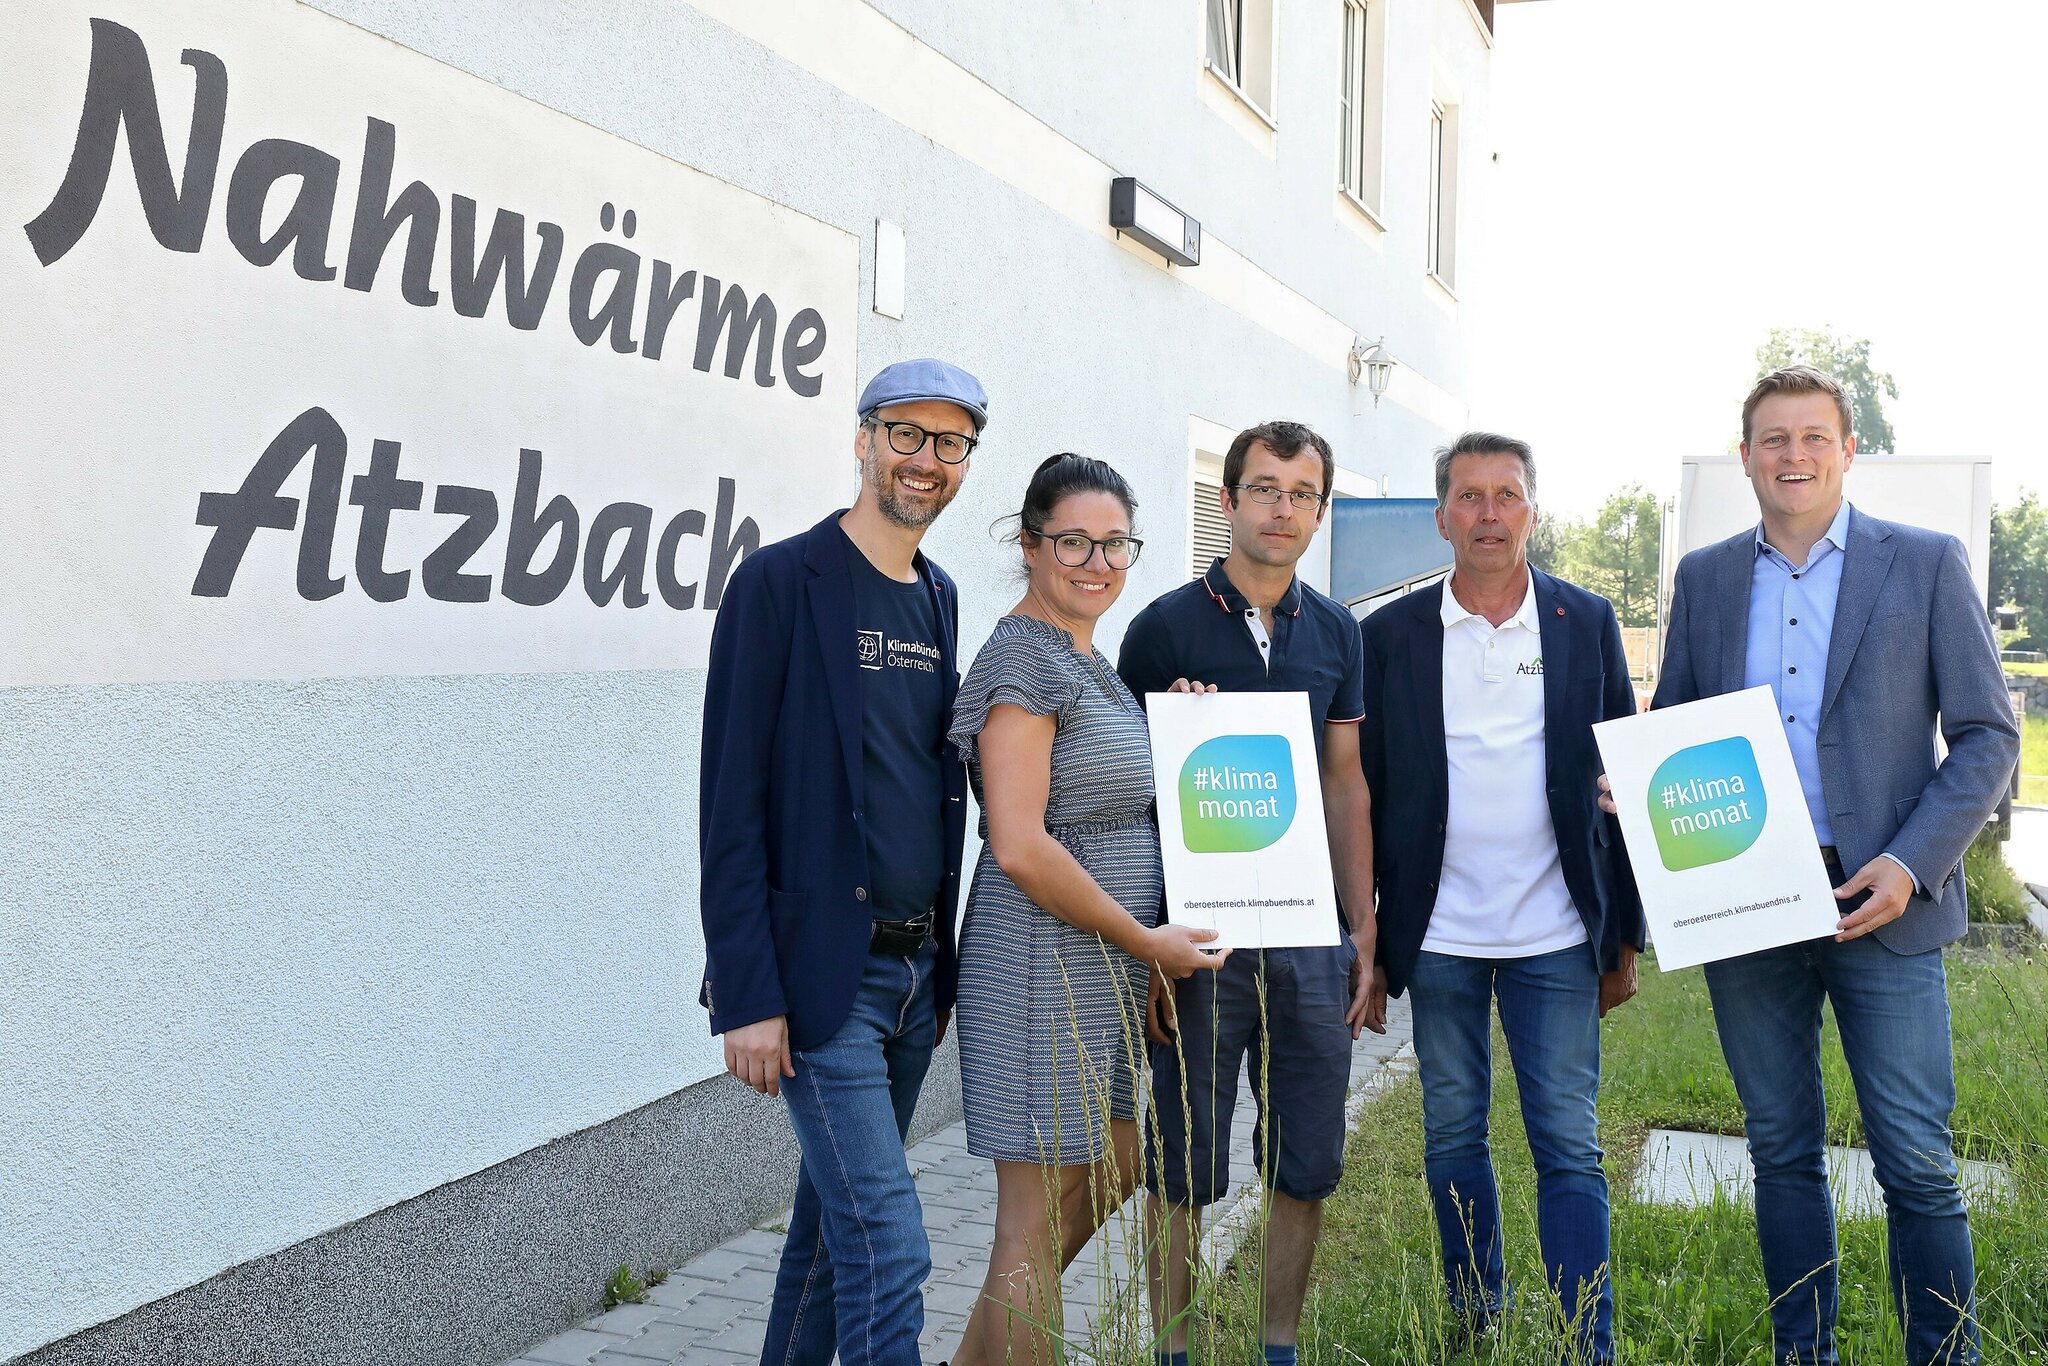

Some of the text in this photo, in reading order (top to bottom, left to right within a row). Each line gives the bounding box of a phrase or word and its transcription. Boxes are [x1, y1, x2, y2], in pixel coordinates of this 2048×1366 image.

[23, 17, 827, 397] Nahwärme
[191, 406, 760, 611] Atzbach
[887, 651, 934, 673] Österreich
[1193, 766, 1278, 791] #klima
[1660, 774, 1746, 810] #klima
[1198, 795, 1279, 819] monat
[1669, 799, 1752, 836] monat
[1184, 898, 1315, 909] oberoesterreich.klimabuendnis.at
[1673, 894, 1801, 928] oberoesterreich.klimabuendnis.at
